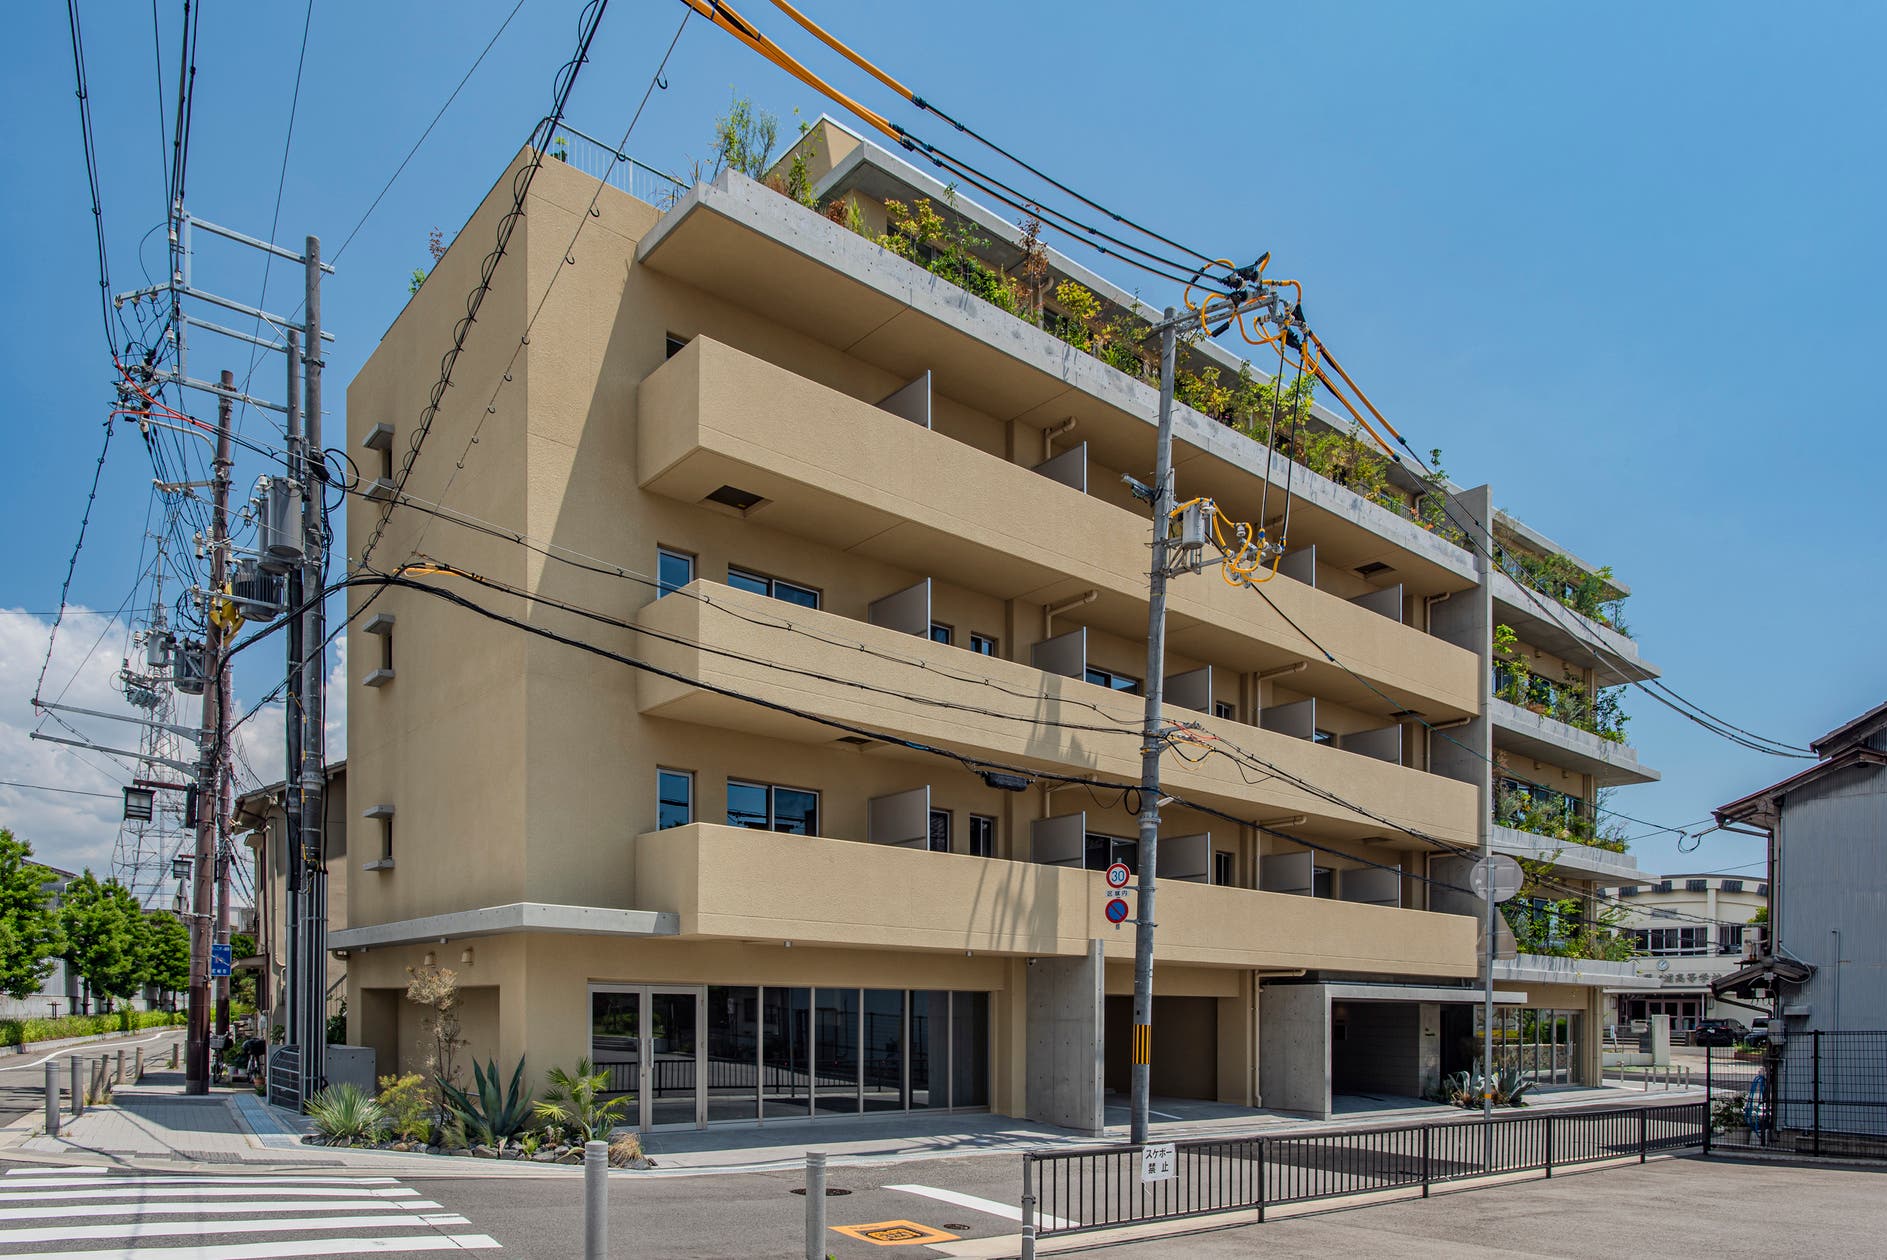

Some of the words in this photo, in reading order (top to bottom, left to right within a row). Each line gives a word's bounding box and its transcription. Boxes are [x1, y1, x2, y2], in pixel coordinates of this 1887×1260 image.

[1111, 870, 1125, 882] 30
[1145, 1148, 1173, 1159] スケボー
[1148, 1161, 1169, 1174] 禁止
